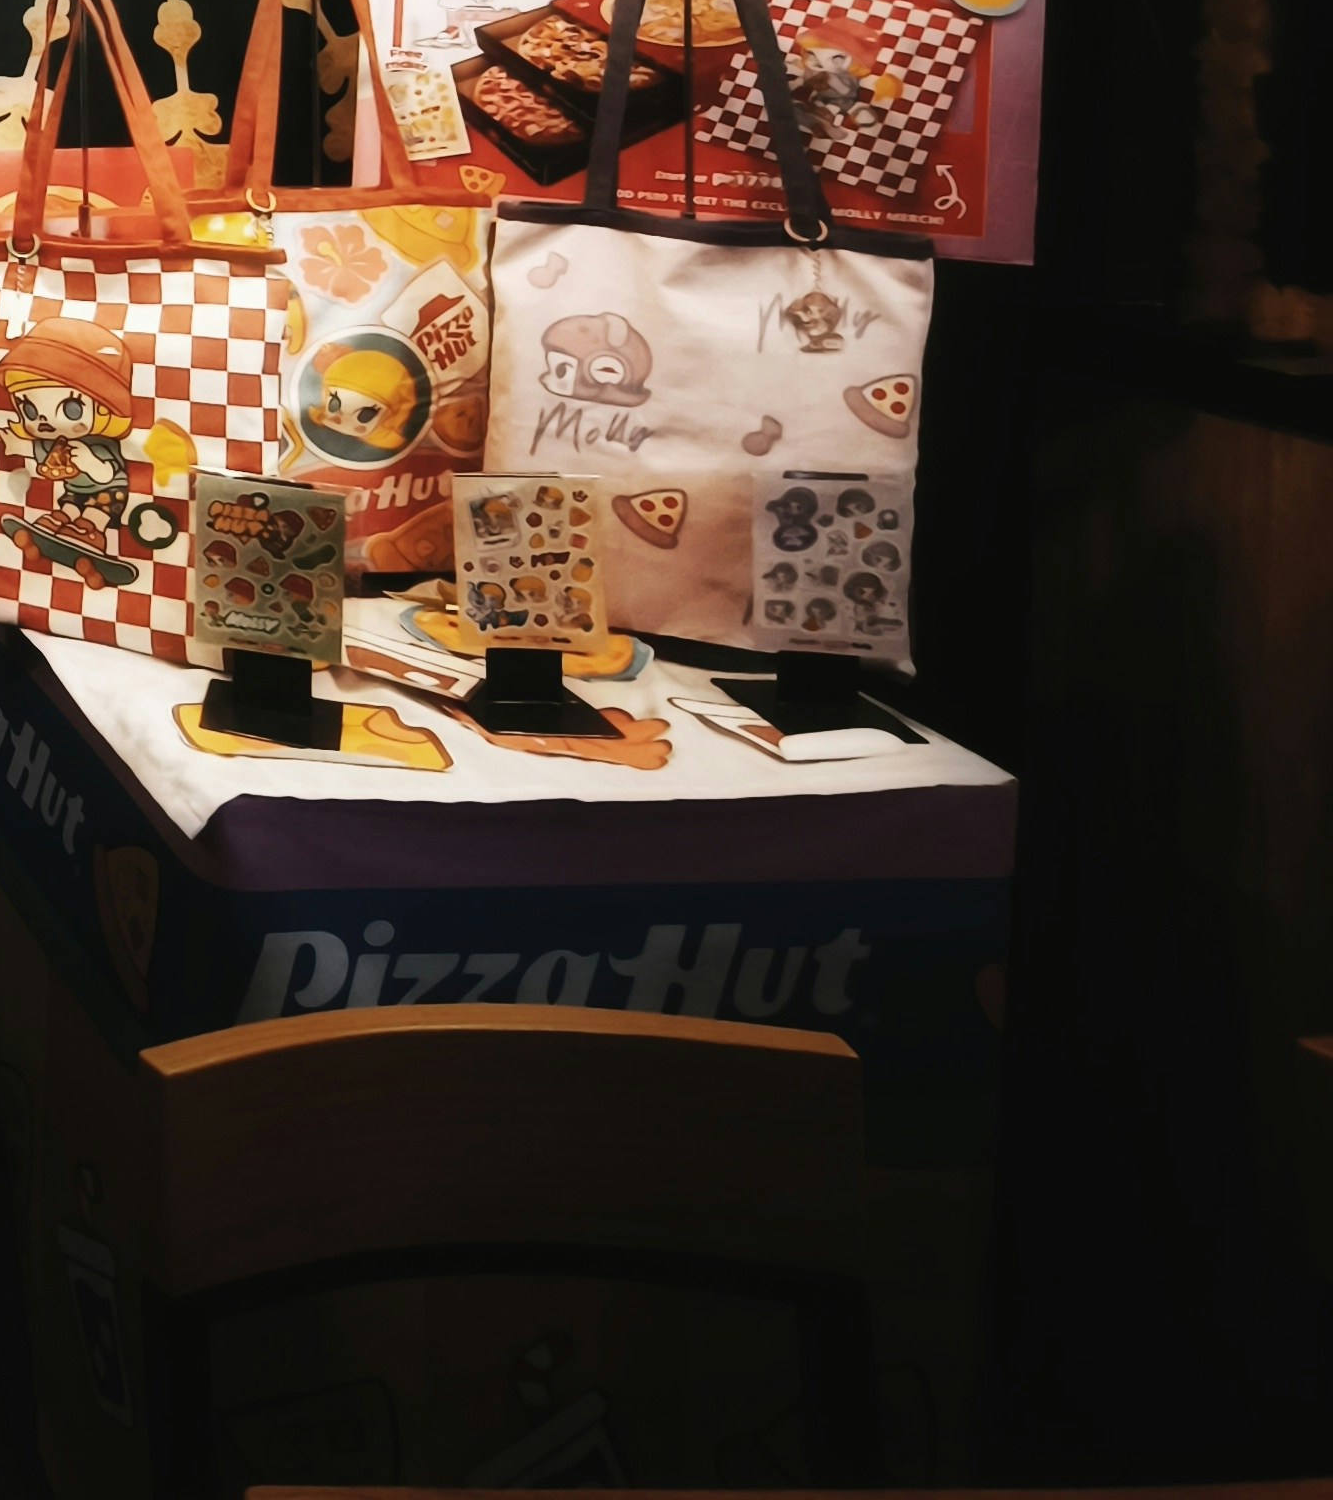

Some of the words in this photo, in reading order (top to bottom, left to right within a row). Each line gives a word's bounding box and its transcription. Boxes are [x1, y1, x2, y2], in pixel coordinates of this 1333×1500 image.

[415, 305, 475, 354] Pizza
[429, 330, 478, 371] Hut
[529, 401, 654, 456] Molly
[7, 720, 86, 856] Hut
[236, 918, 603, 1028] Pizza
[608, 922, 873, 1020] Hut
